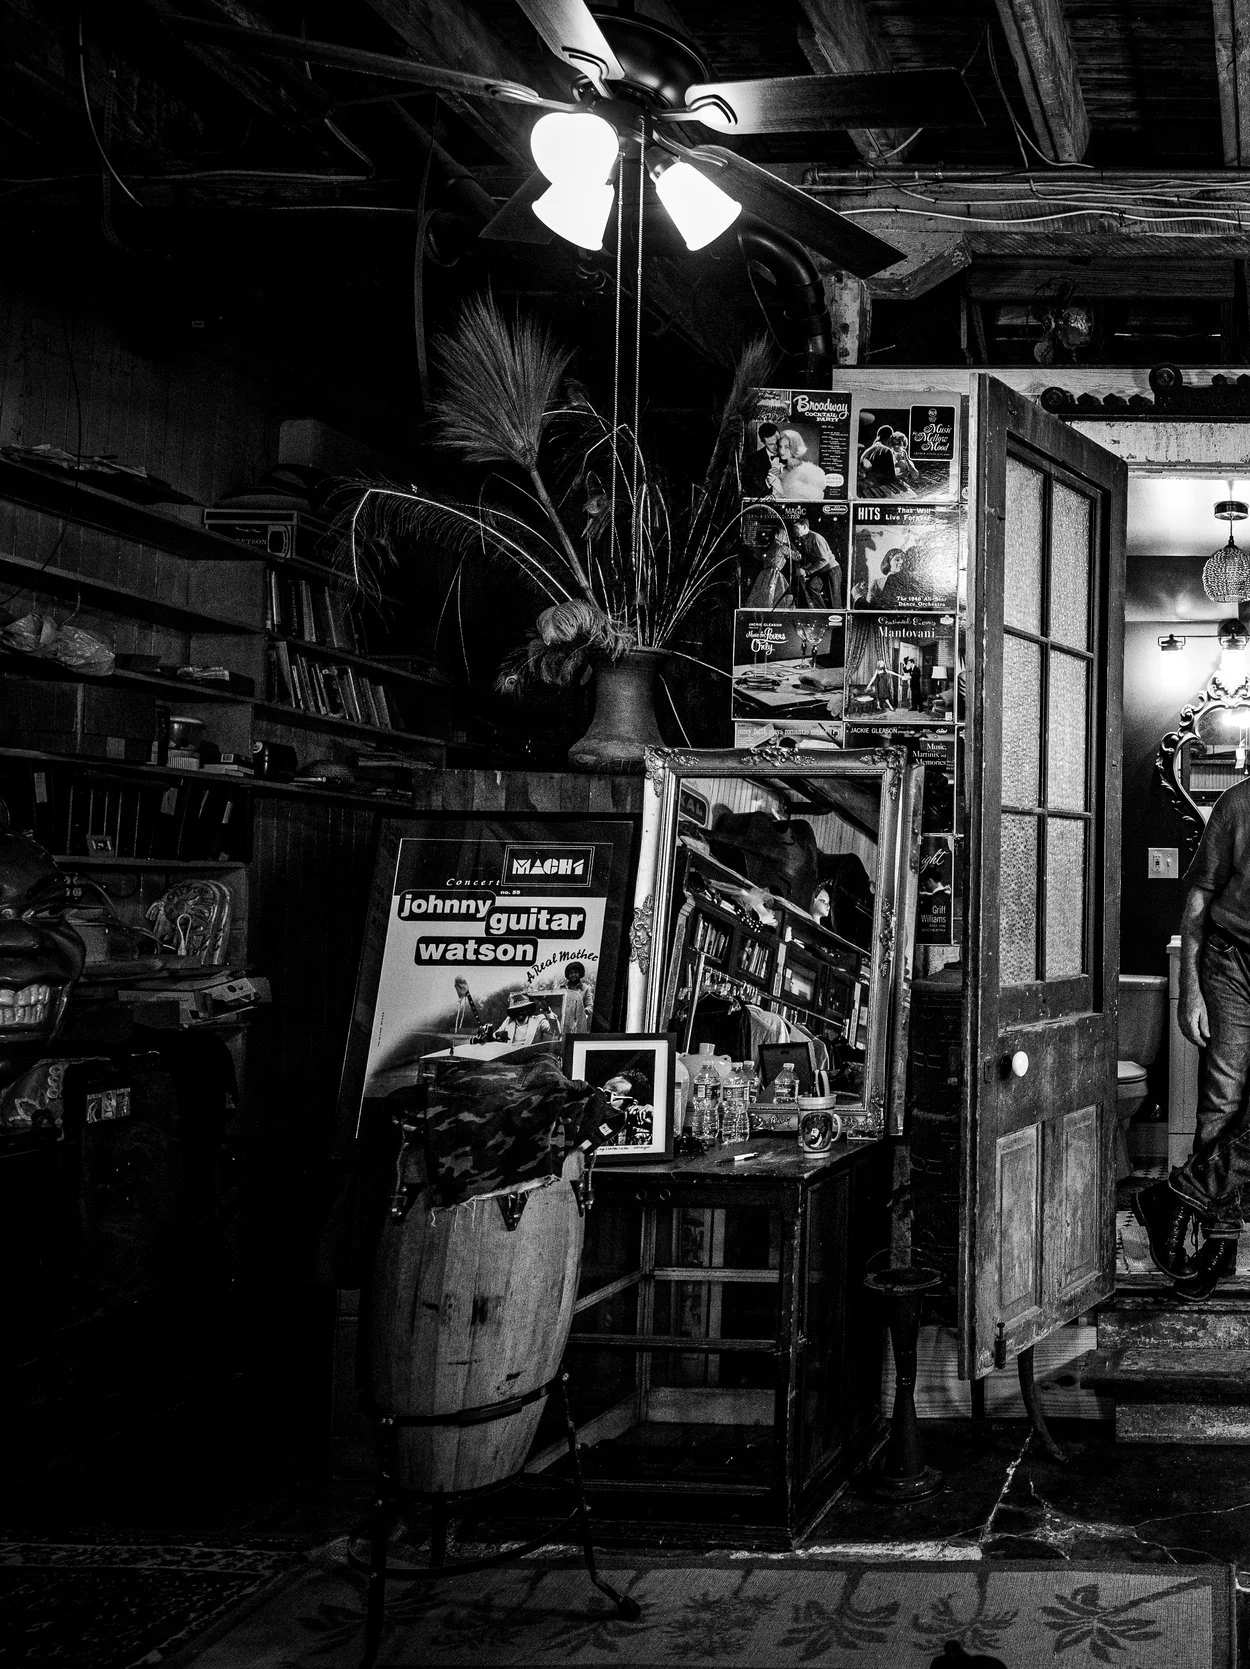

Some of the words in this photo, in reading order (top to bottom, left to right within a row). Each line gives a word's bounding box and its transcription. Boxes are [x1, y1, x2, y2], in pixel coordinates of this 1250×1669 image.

[793, 394, 849, 420] Broadway
[923, 423, 953, 434] Music
[914, 432, 949, 443] Mellow
[921, 442, 950, 452] Mood
[858, 507, 881, 520] HITS
[879, 626, 935, 638] Mantovani
[926, 743, 947, 751] Music,
[916, 758, 947, 766] Memories
[446, 878, 501, 887] Concert
[400, 894, 493, 918] johnny
[932, 905, 946, 914] Griff
[489, 907, 584, 935] guitar
[921, 914, 947, 923] Williams
[418, 939, 535, 962] watson
[526, 971, 536, 984] A
[531, 952, 558, 977] Real
